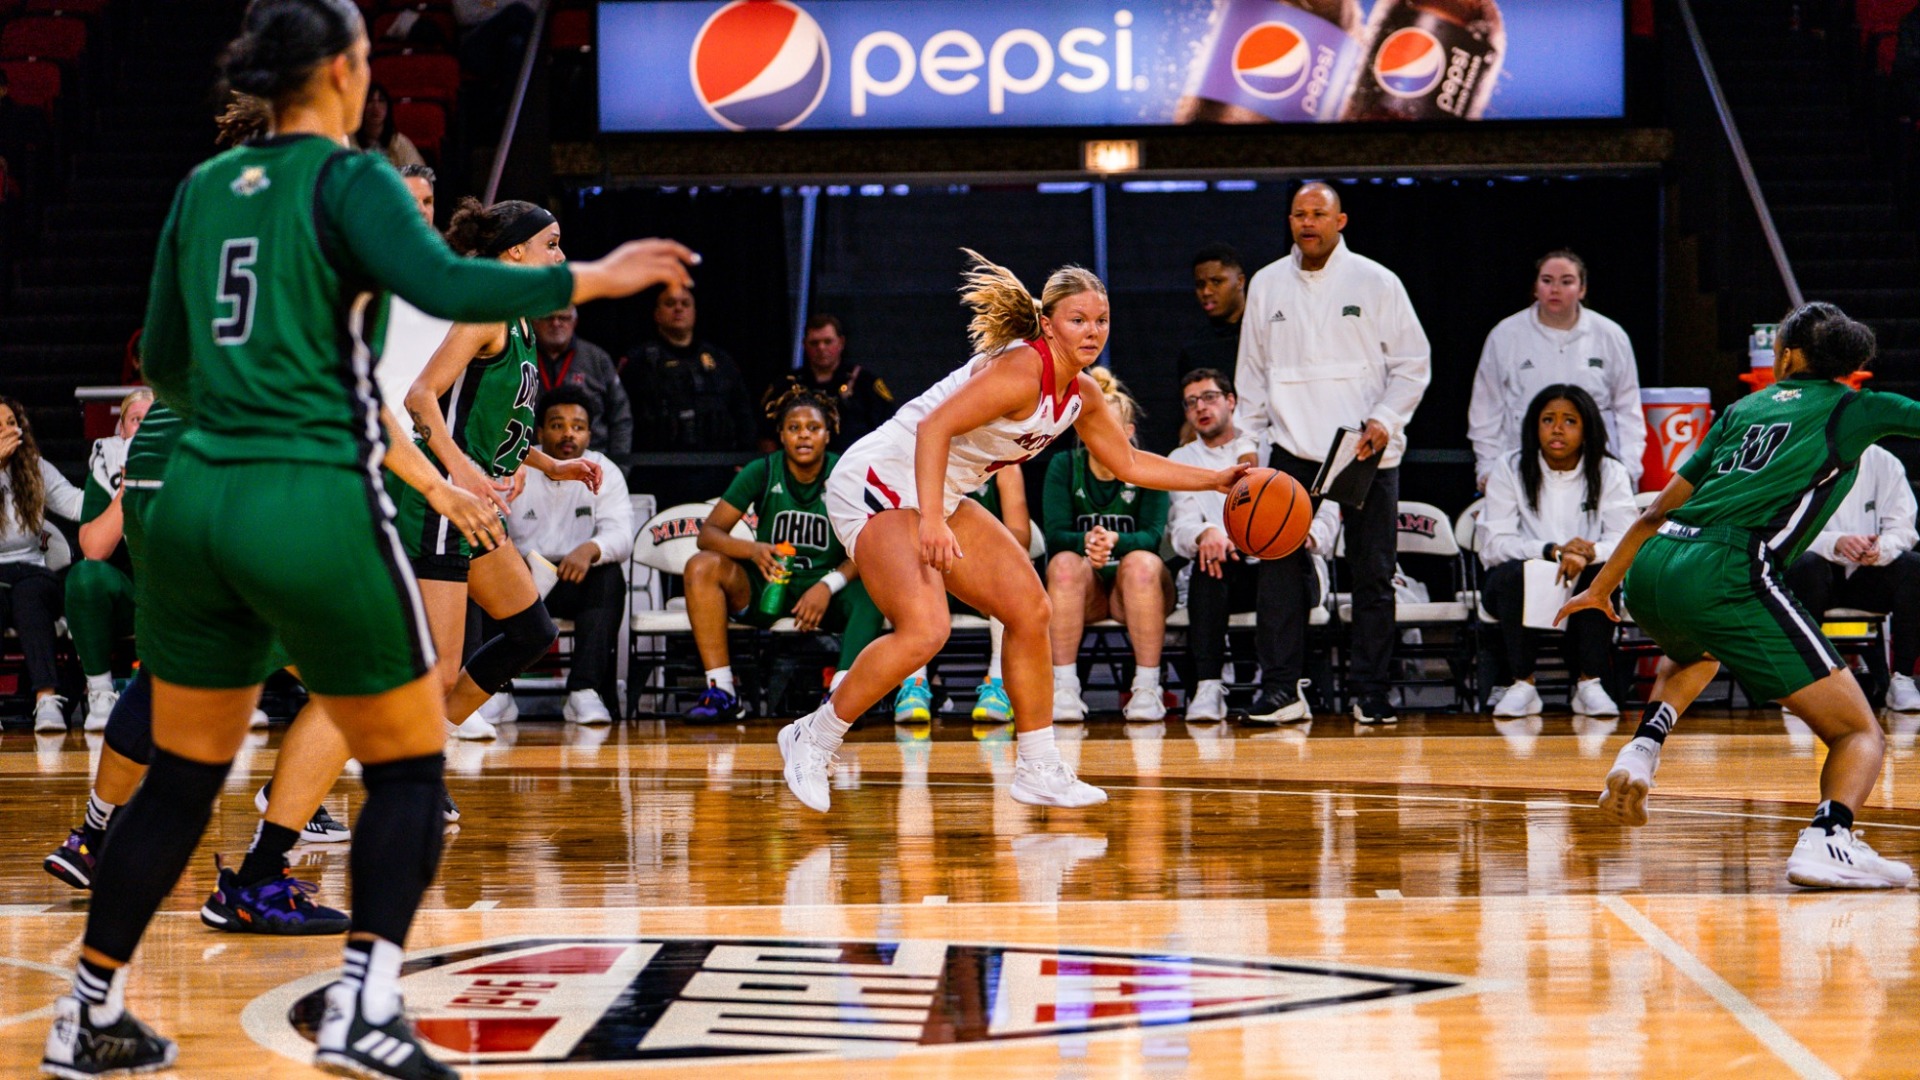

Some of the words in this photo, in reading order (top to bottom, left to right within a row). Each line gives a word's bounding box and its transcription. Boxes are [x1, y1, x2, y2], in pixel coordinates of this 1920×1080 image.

[851, 10, 1133, 116] pepsi
[1301, 44, 1336, 116] pepsi
[1436, 46, 1471, 114] pepsi
[211, 236, 259, 346] 5
[1717, 422, 1792, 474] 10
[650, 517, 702, 546] MIA
[771, 510, 829, 551] OHIO
